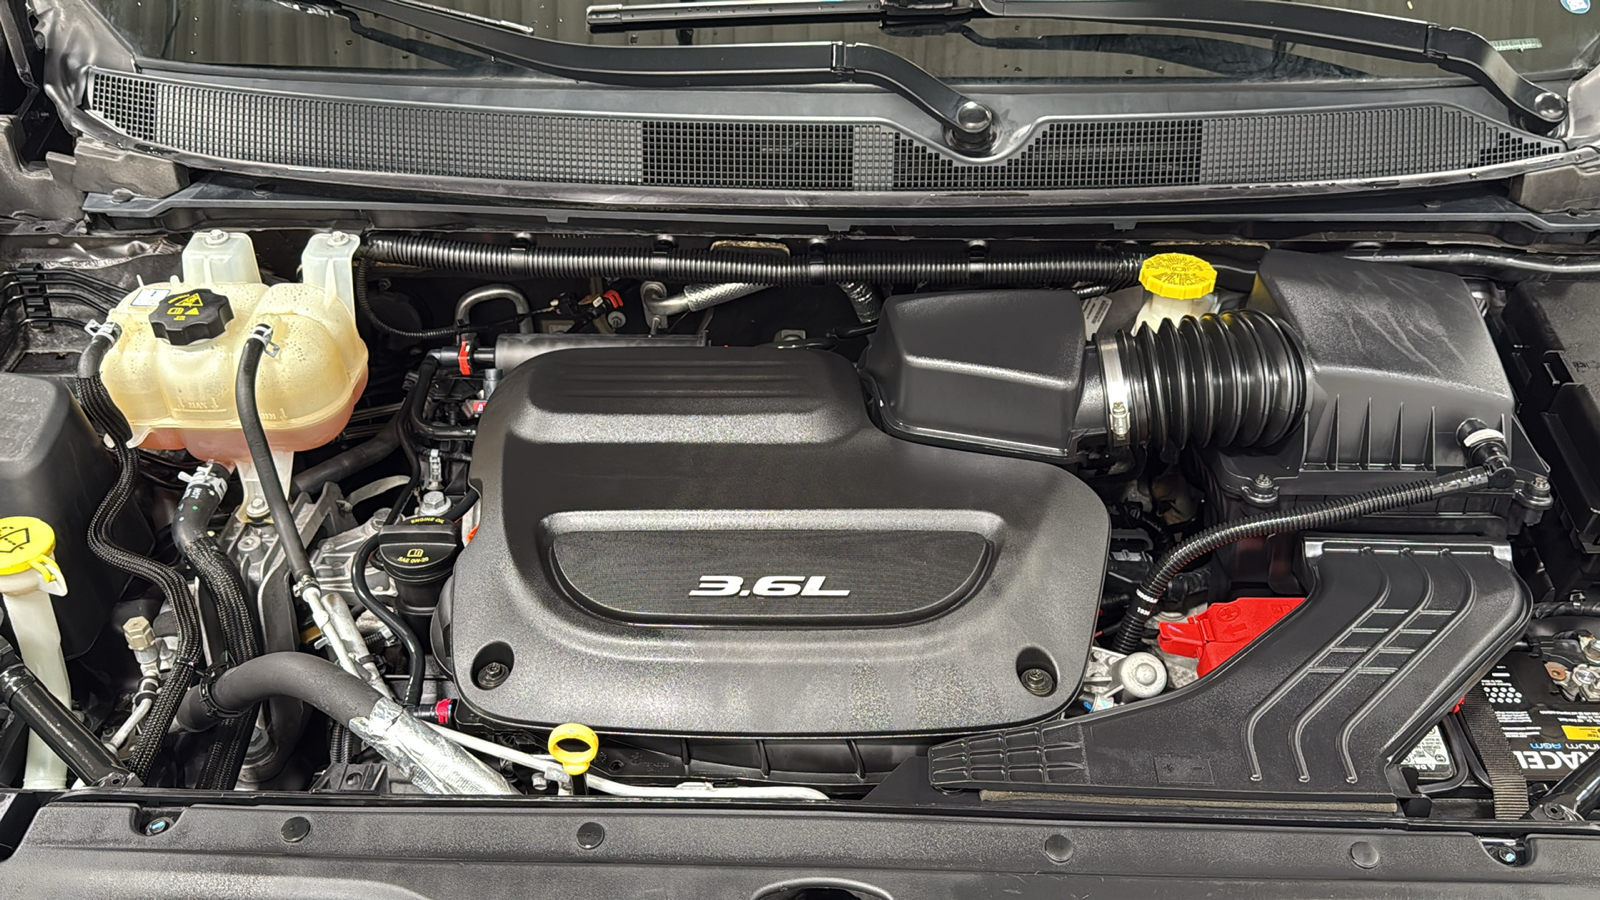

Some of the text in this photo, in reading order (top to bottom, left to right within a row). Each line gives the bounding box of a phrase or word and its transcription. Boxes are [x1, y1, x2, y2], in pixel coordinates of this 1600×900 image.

[410, 556, 430, 564] 0W-20
[688, 575, 851, 597] 3.6L
[1529, 742, 1562, 750] AGM
